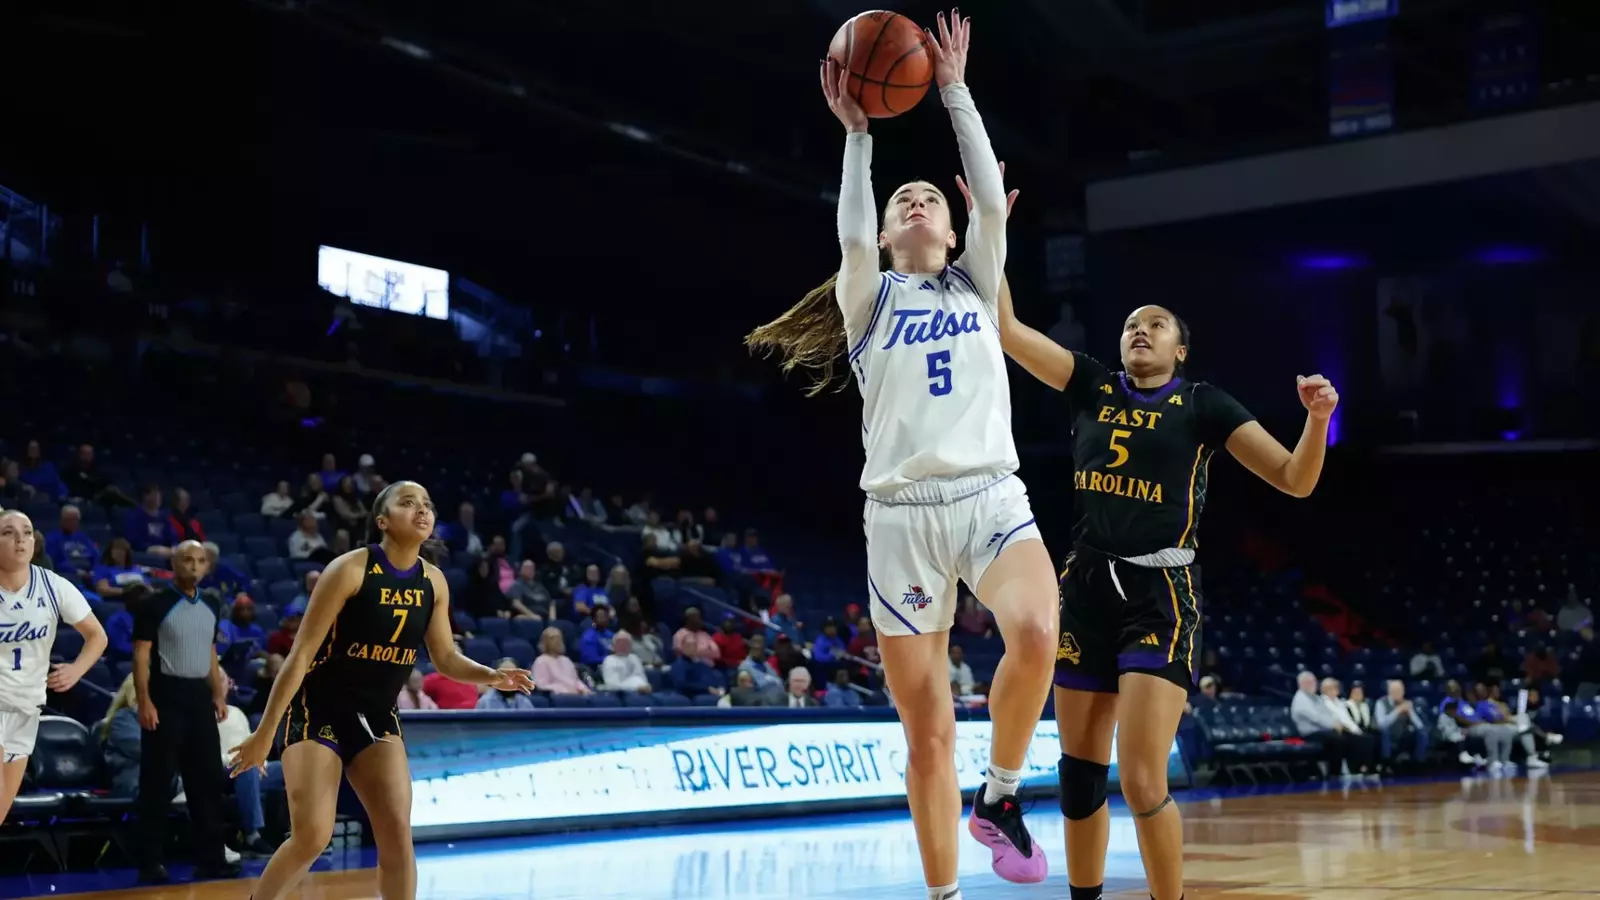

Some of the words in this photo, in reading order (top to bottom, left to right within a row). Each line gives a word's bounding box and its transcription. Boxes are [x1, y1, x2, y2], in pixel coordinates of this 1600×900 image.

[882, 308, 981, 350] Tulsa
[926, 350, 952, 396] 5
[1097, 405, 1161, 429] EAST
[1106, 429, 1132, 468] 5
[380, 587, 424, 607] EAST
[901, 593, 932, 604] Tulsa
[390, 609, 408, 643] 7
[12, 648, 21, 671] 1
[347, 642, 417, 665] CAROLIN
[672, 746, 791, 792] RIVER
[787, 741, 880, 785] SPIRIT
